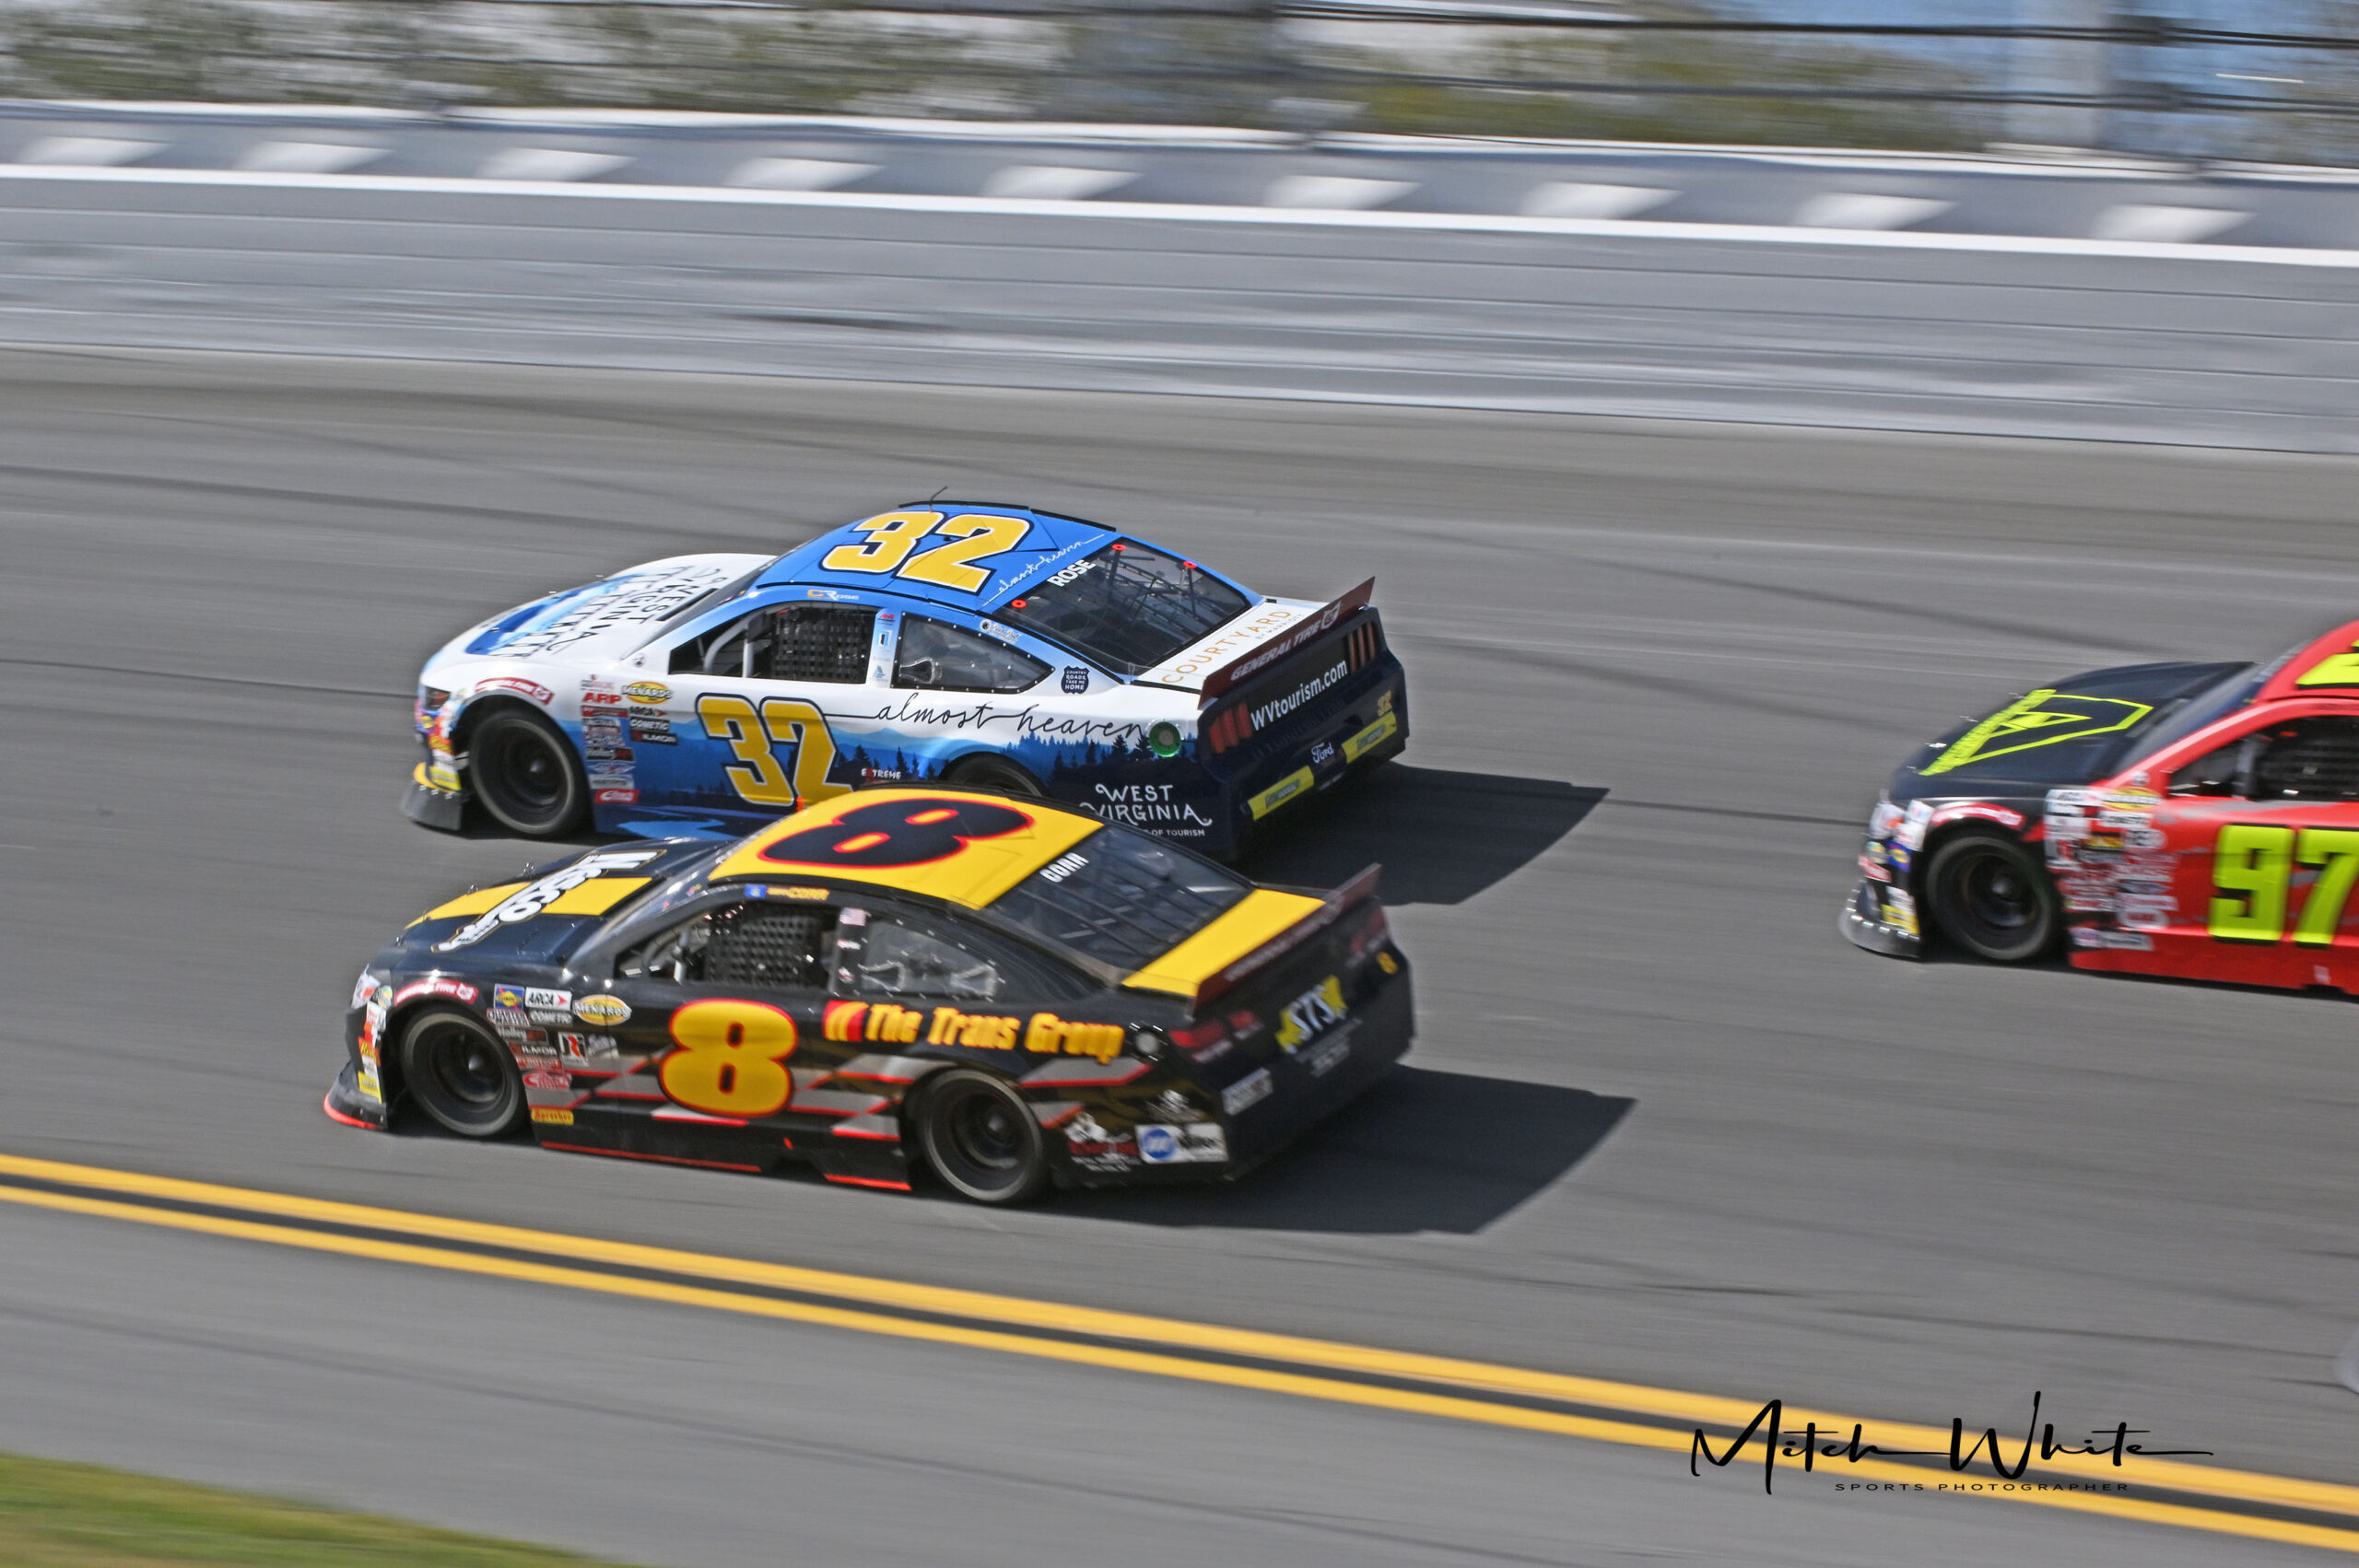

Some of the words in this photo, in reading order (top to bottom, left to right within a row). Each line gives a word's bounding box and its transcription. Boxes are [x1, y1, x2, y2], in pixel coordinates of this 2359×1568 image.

[818, 510, 1034, 596] 32
[1047, 559, 1097, 588] ROSE
[982, 558, 1042, 607] almost
[1161, 611, 1291, 683] COURTYARD
[1230, 638, 1292, 681] GENERAL
[1292, 620, 1322, 648] TIRE
[582, 693, 622, 705] ARP
[874, 692, 995, 730] almost
[1016, 703, 1148, 738] heaven
[1250, 660, 1348, 731] WVtourism.com
[630, 719, 671, 731] COMETIC
[696, 692, 855, 810] 32
[861, 767, 902, 780] EXTREME
[1310, 743, 1335, 764] Ford
[1078, 802, 1214, 827] VIRGINIA
[1095, 783, 1174, 802] WEST
[756, 797, 1037, 871] 8
[2207, 821, 2359, 949] 97
[528, 990, 555, 1005] ARCA
[572, 1000, 631, 1018] MENARDS
[522, 1045, 557, 1057] ILMOR
[864, 1003, 923, 1044] The
[926, 1007, 1021, 1050] Trans
[1024, 1012, 1125, 1065] Group
[658, 997, 799, 1118] 8
